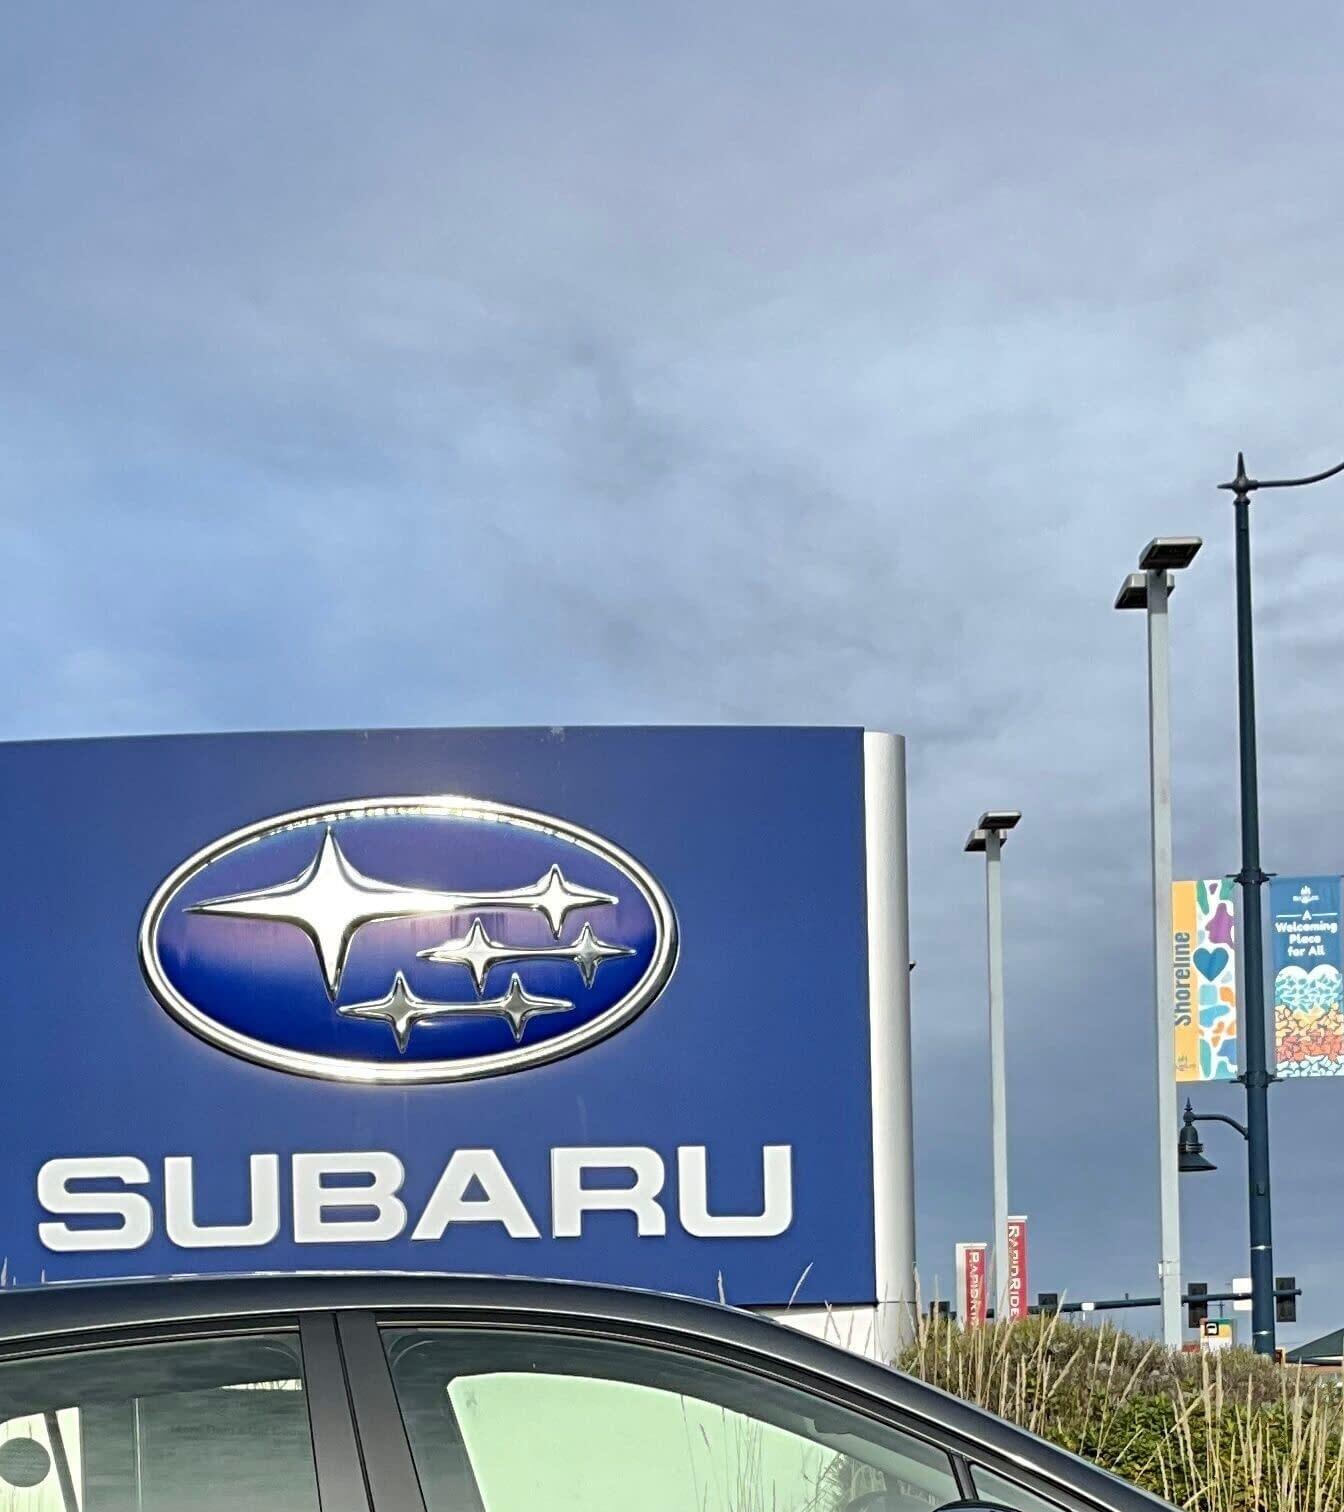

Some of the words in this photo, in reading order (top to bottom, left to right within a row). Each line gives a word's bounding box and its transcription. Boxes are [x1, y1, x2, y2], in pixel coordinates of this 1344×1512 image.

[1302, 910, 1312, 921] A
[1275, 921, 1338, 933] Welcoming
[1289, 933, 1321, 945] Place
[1288, 946, 1305, 957] for
[1308, 945, 1325, 956] All
[1173, 931, 1191, 1026] Shoreline
[37, 1144, 793, 1251] SUBARU
